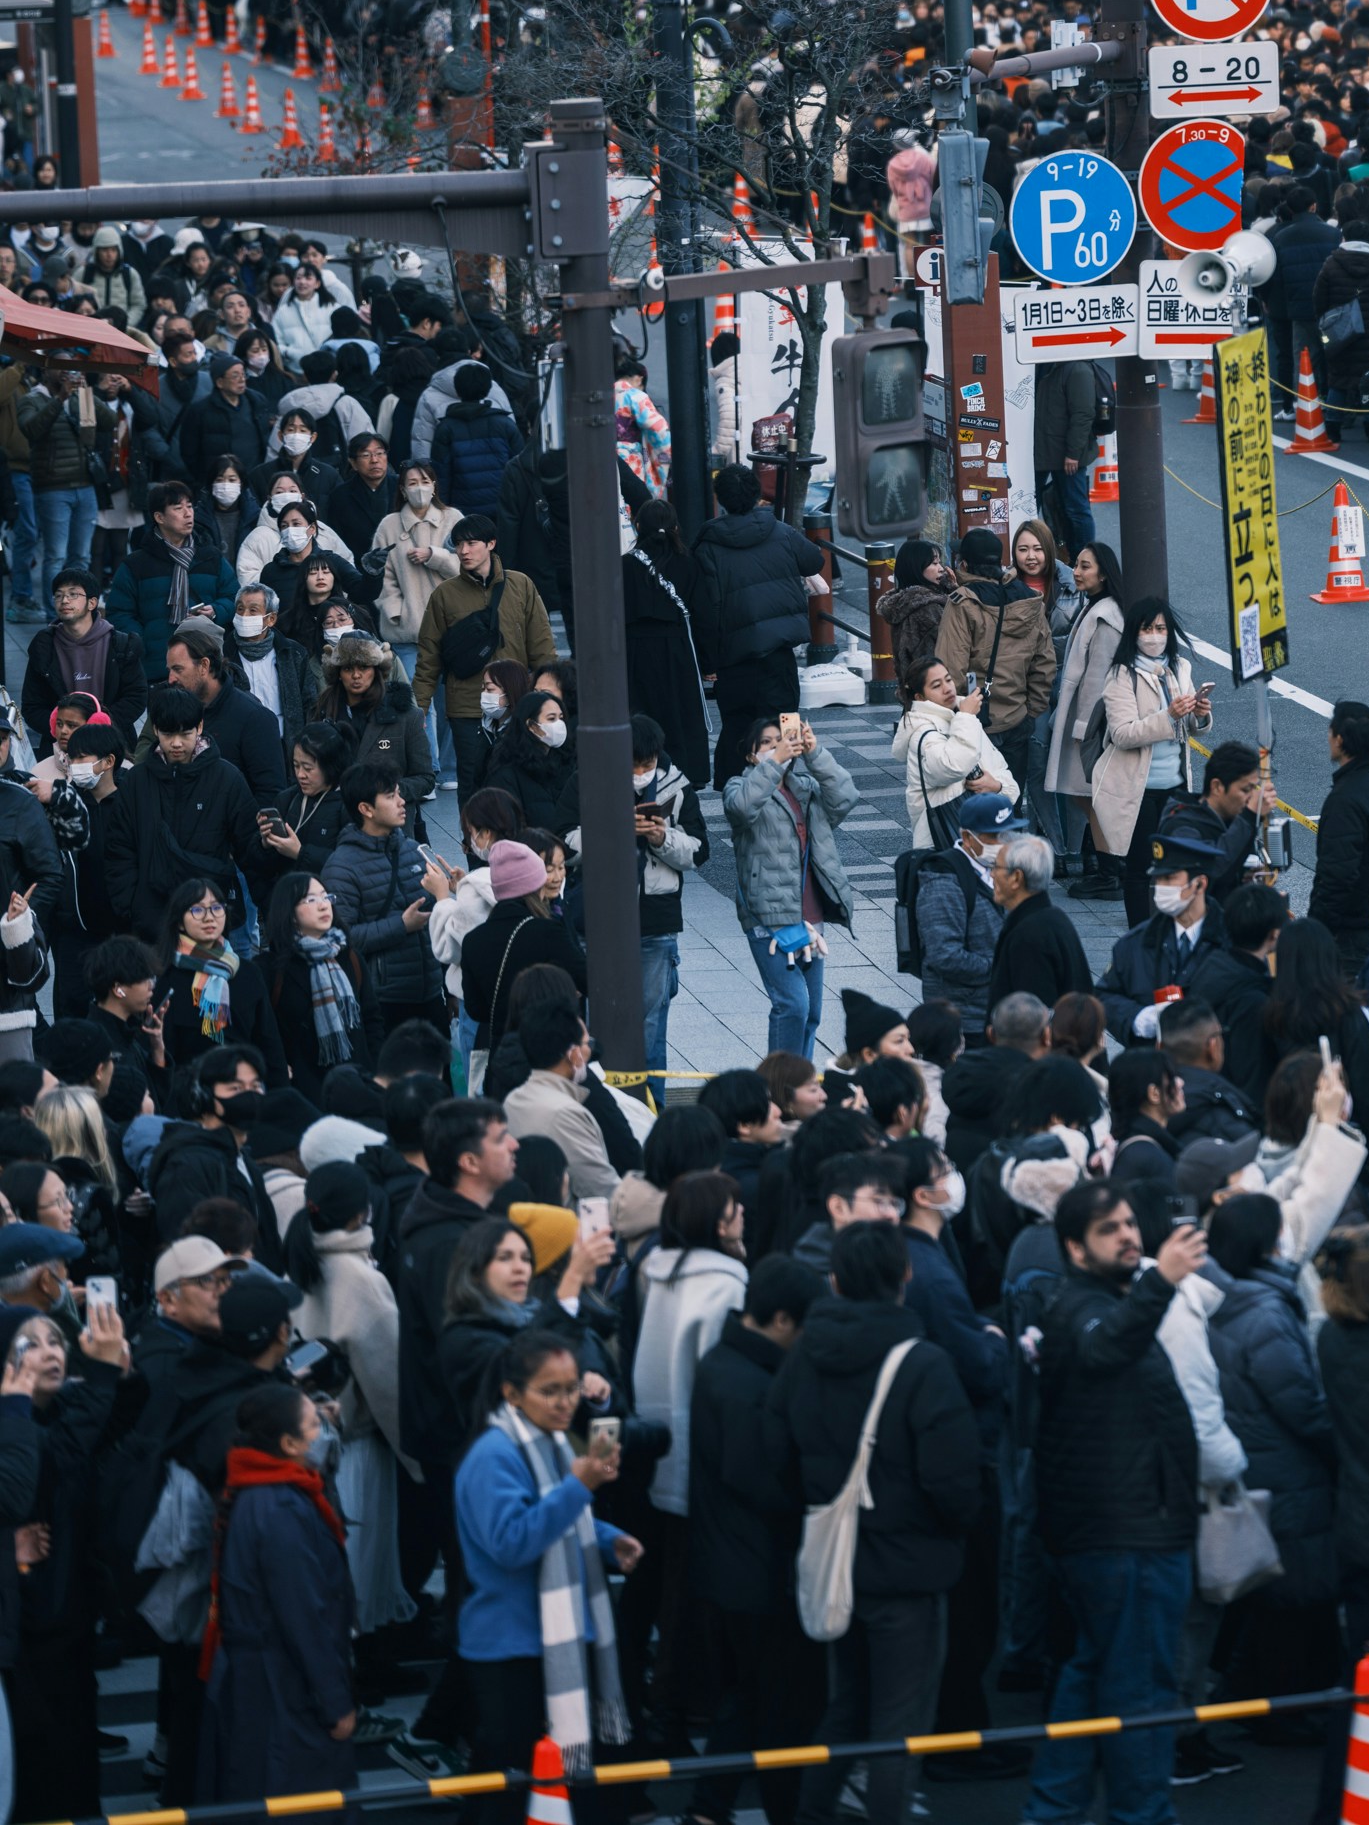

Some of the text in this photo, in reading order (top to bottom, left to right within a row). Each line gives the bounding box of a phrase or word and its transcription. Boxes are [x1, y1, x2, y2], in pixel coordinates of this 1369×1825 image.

[1108, 209, 1121, 232] 分
[1041, 189, 1108, 271] P 60
[761, 423, 788, 437] 休止中
[1099, 471, 1118, 482] 警視
[1250, 350, 1282, 618] 終わりの日に人は
[1334, 576, 1360, 586] 警視庁
